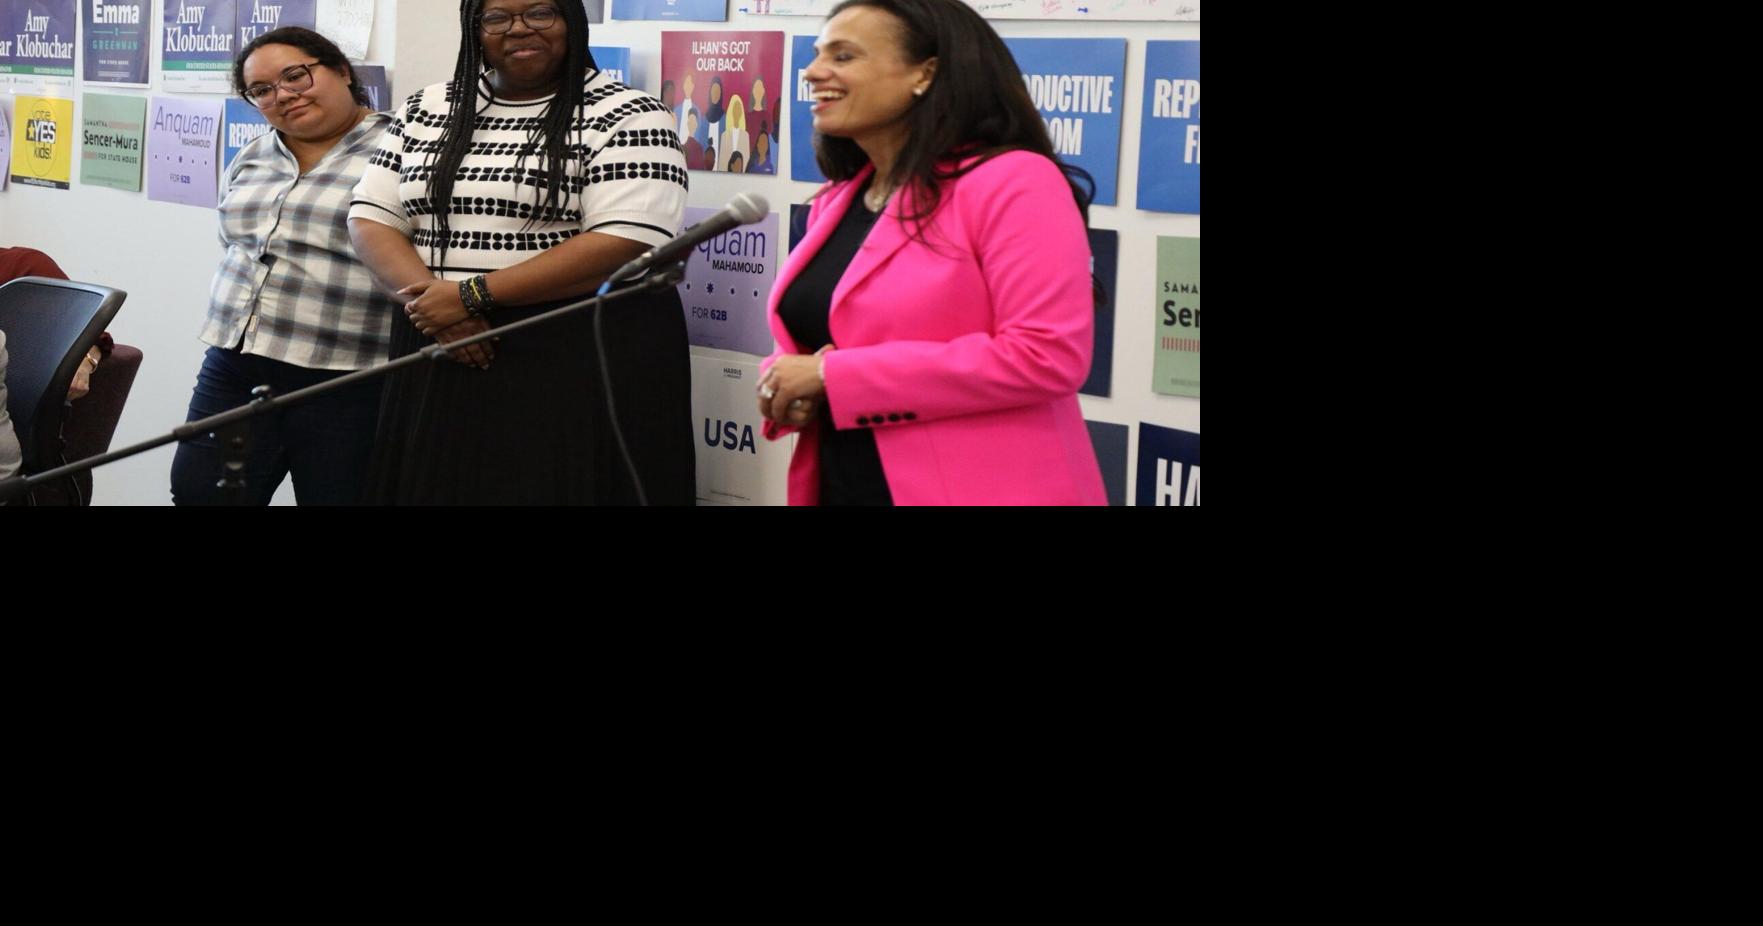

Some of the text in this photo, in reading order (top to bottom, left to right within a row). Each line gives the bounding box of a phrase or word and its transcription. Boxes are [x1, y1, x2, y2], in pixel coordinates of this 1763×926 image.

[24, 8, 50, 40] Amy
[93, 0, 139, 24] Emma
[176, 0, 206, 32] Amy
[251, 0, 283, 31] Amy
[16, 34, 73, 59] Klobuchar
[165, 26, 233, 52] Klobuchar
[692, 41, 751, 55] ILHAN'S GOT
[696, 58, 745, 72] OUR BACK
[34, 120, 56, 144] YES
[153, 106, 213, 140] Anquam
[84, 129, 138, 150] Sencer-Mura
[1042, 117, 1083, 155] OM
[712, 260, 764, 274] MAHAMOUD
[691, 307, 727, 321] FOR 62B
[704, 417, 756, 455] USA
